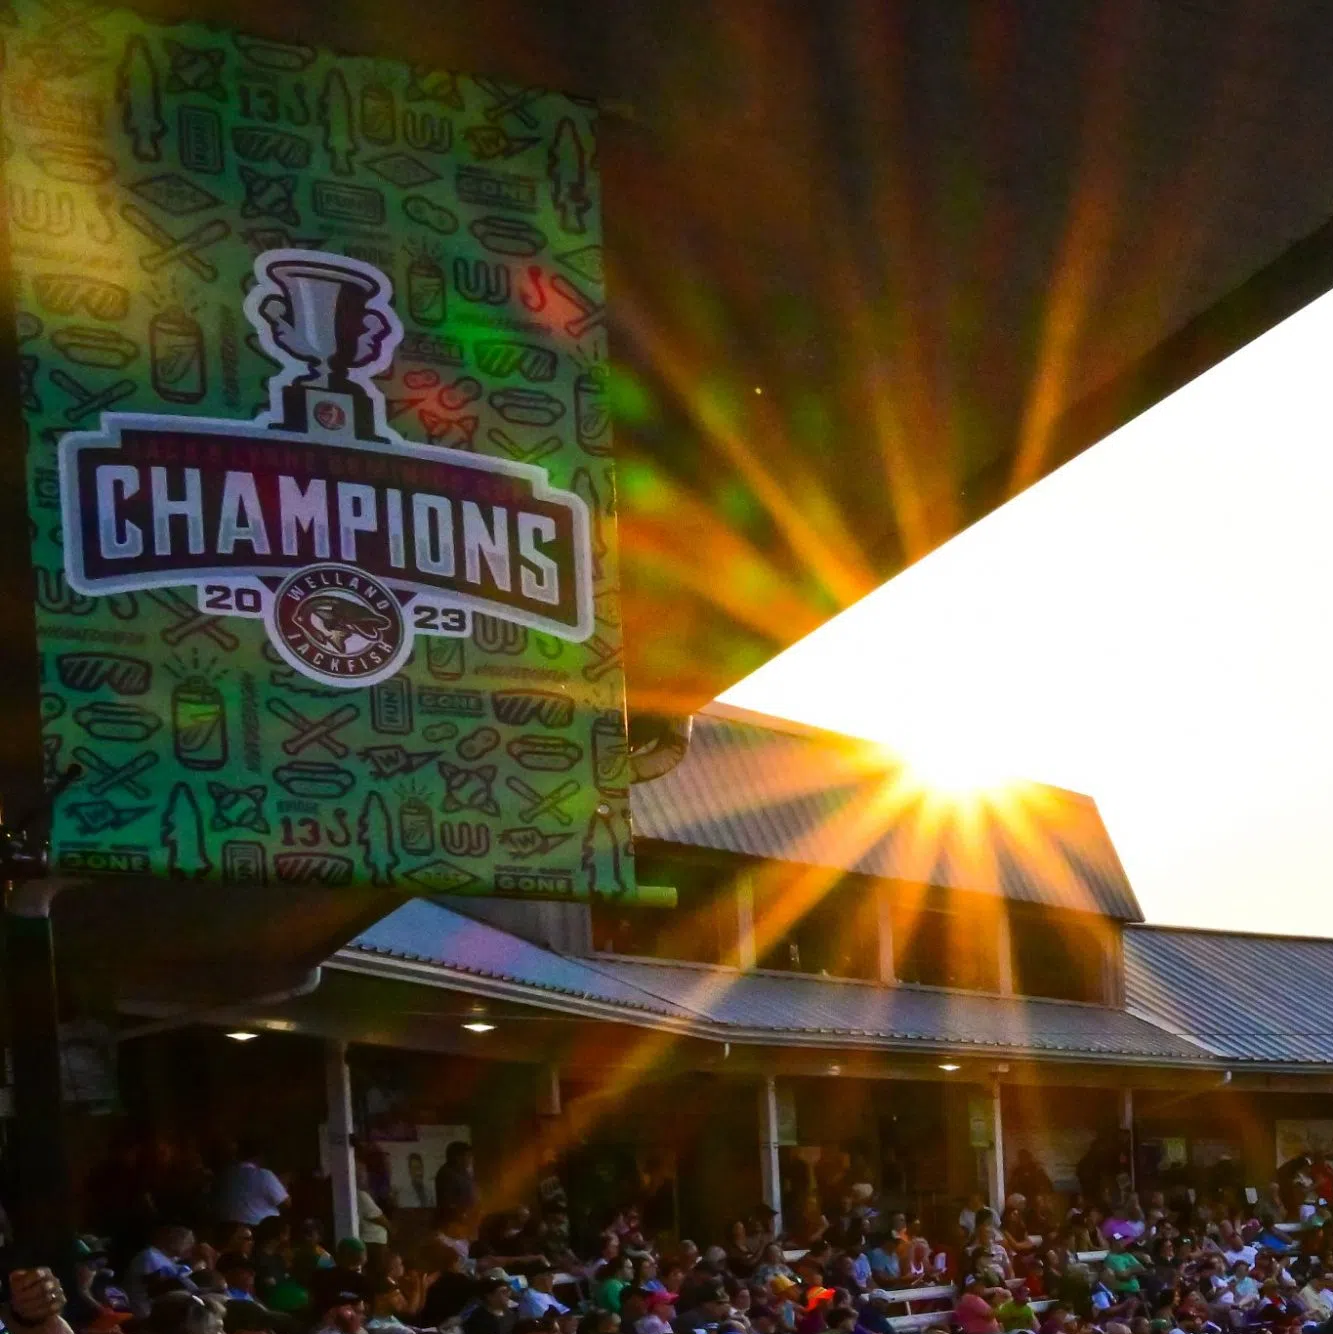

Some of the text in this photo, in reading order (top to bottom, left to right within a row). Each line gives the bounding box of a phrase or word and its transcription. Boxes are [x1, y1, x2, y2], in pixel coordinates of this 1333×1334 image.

[95, 464, 561, 606] CHAMPIONS
[205, 584, 263, 613] 20
[286, 572, 392, 610] WELLAND
[414, 606, 467, 632] 23
[288, 633, 394, 673] JACKFISH
[281, 816, 321, 846] 13
